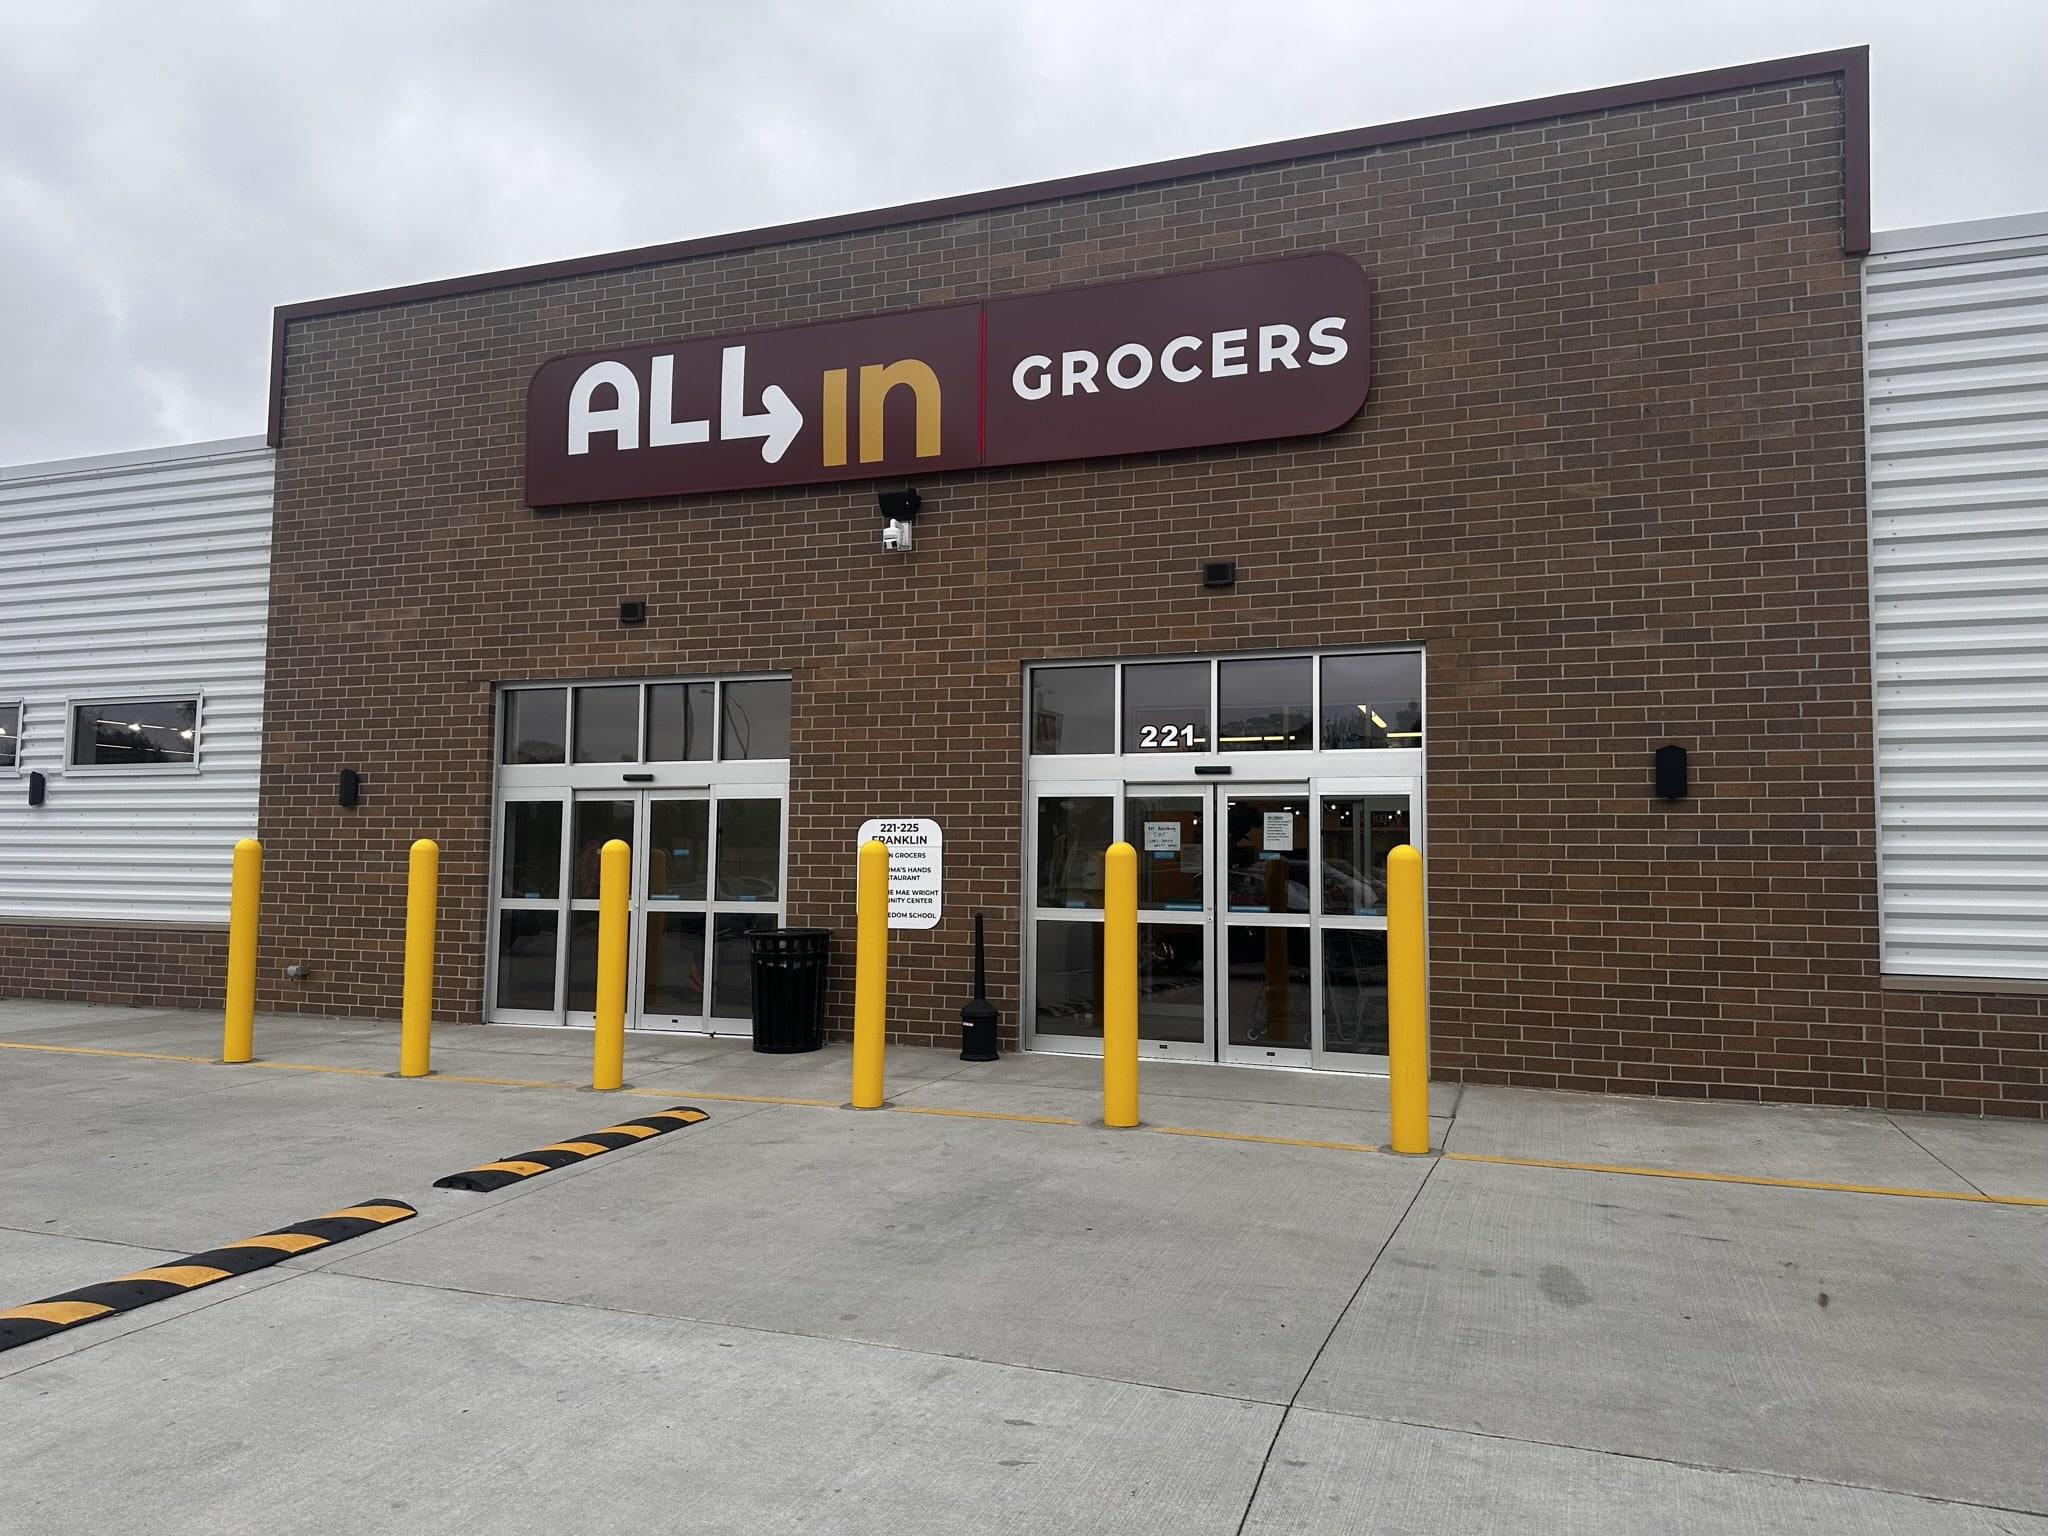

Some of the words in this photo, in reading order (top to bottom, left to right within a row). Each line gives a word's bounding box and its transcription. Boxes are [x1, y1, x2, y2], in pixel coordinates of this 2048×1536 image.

[567, 345, 804, 464] ALL
[1012, 316, 1348, 401] GROCERS
[1140, 724, 1194, 748] 221
[880, 823, 919, 833] 221-225
[907, 866, 932, 874] HANDS
